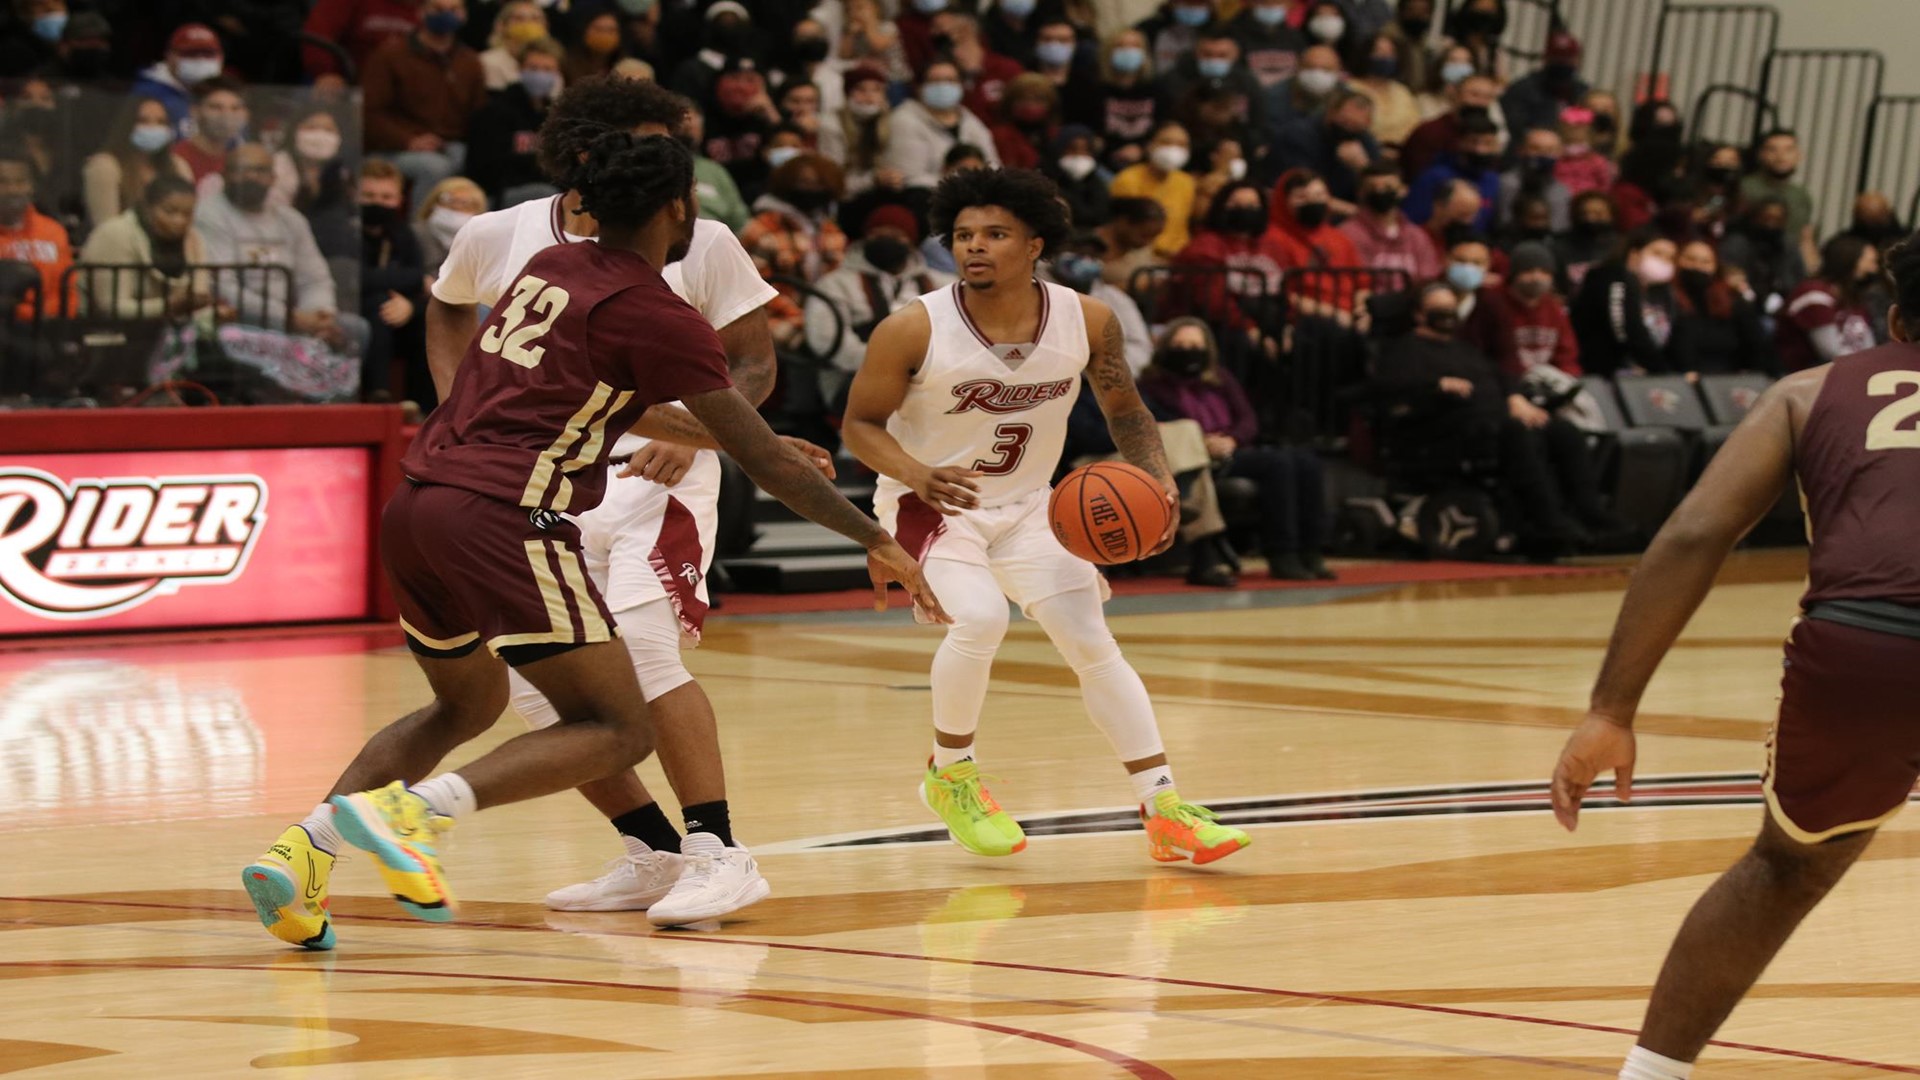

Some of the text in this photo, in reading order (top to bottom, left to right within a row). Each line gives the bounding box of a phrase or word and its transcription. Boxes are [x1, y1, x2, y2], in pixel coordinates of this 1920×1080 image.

[480, 275, 569, 369] 32
[944, 378, 1073, 414] RIDER
[1865, 370, 1920, 451] 2
[972, 422, 1032, 476] 3
[1090, 494, 1119, 526] THE
